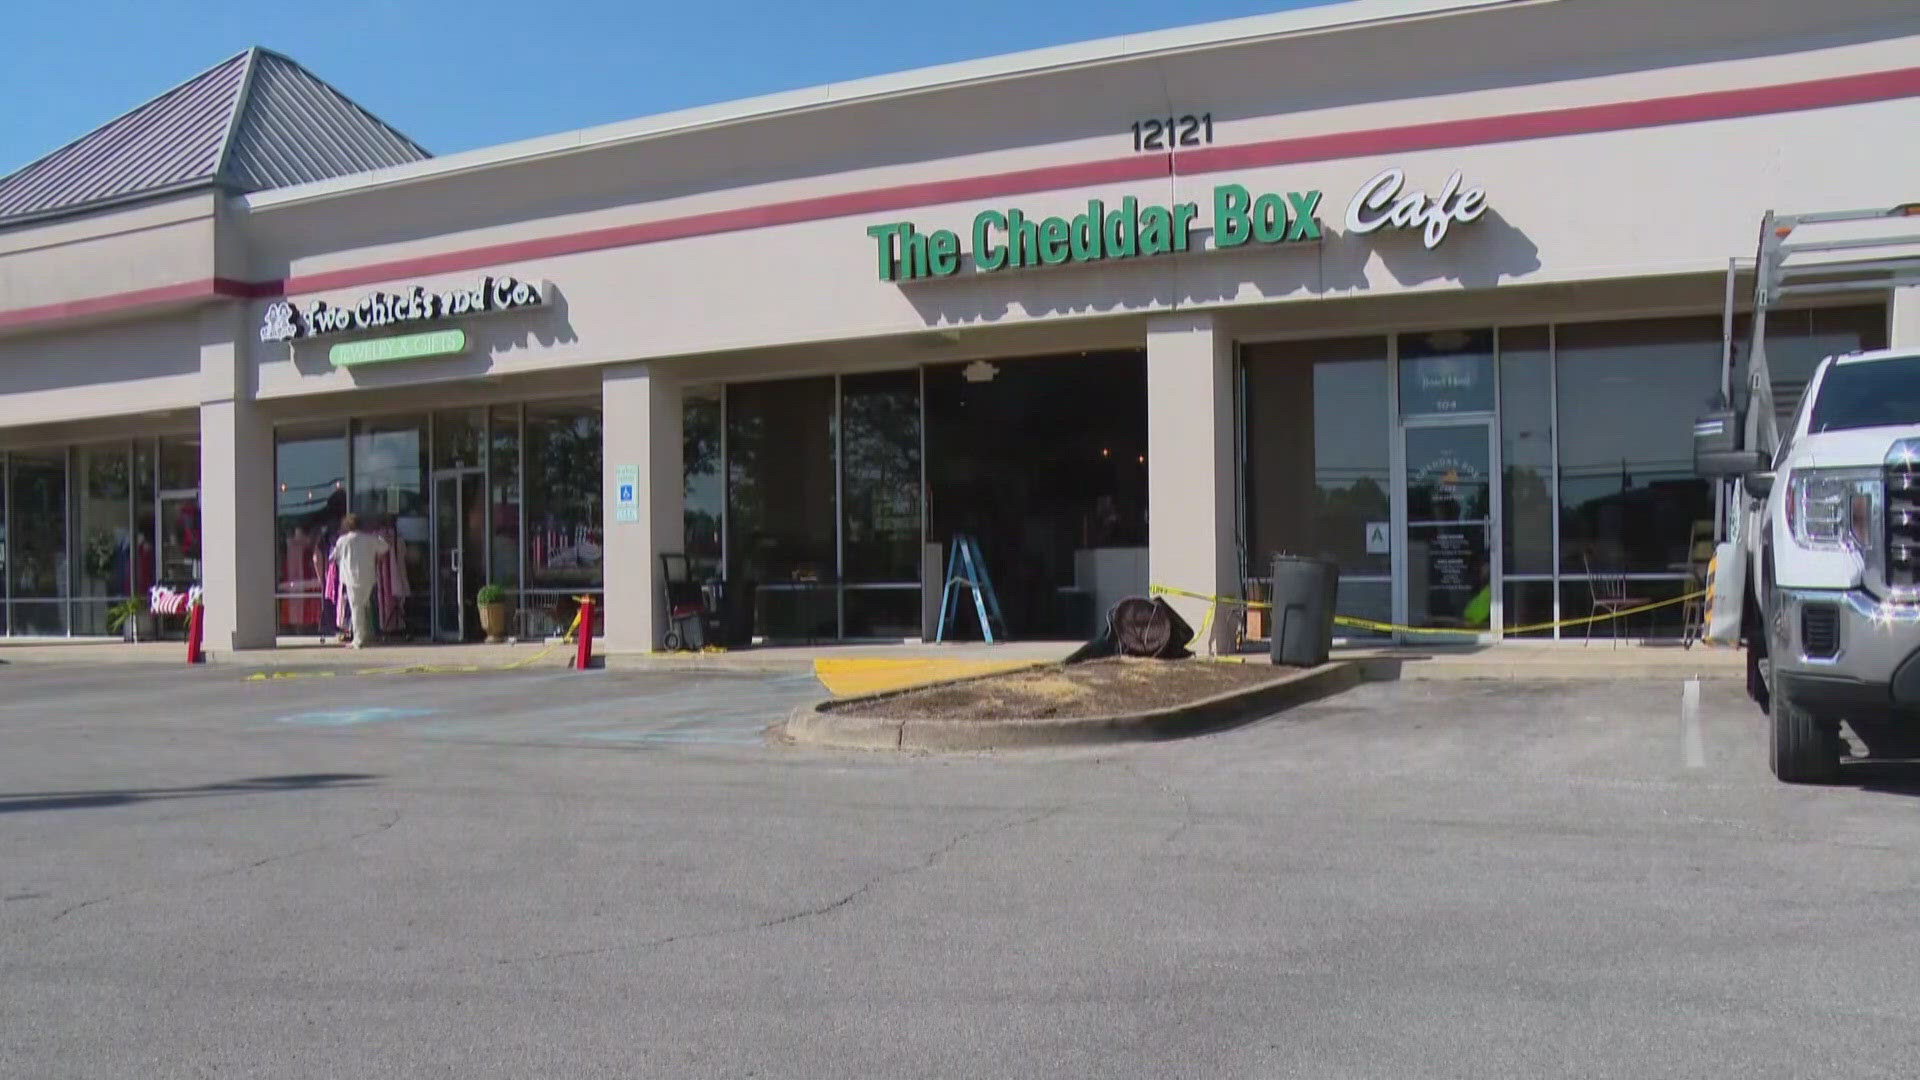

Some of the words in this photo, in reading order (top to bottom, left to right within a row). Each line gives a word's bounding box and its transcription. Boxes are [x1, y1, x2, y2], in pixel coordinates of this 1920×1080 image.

[1131, 113, 1214, 151] 12121
[867, 222, 959, 282] The
[971, 196, 1199, 271] Cheddar
[1213, 183, 1323, 248] Box
[1344, 167, 1488, 249] Cafe
[302, 300, 350, 335] Two
[354, 285, 435, 329] Chicks
[493, 275, 538, 308] Co.
